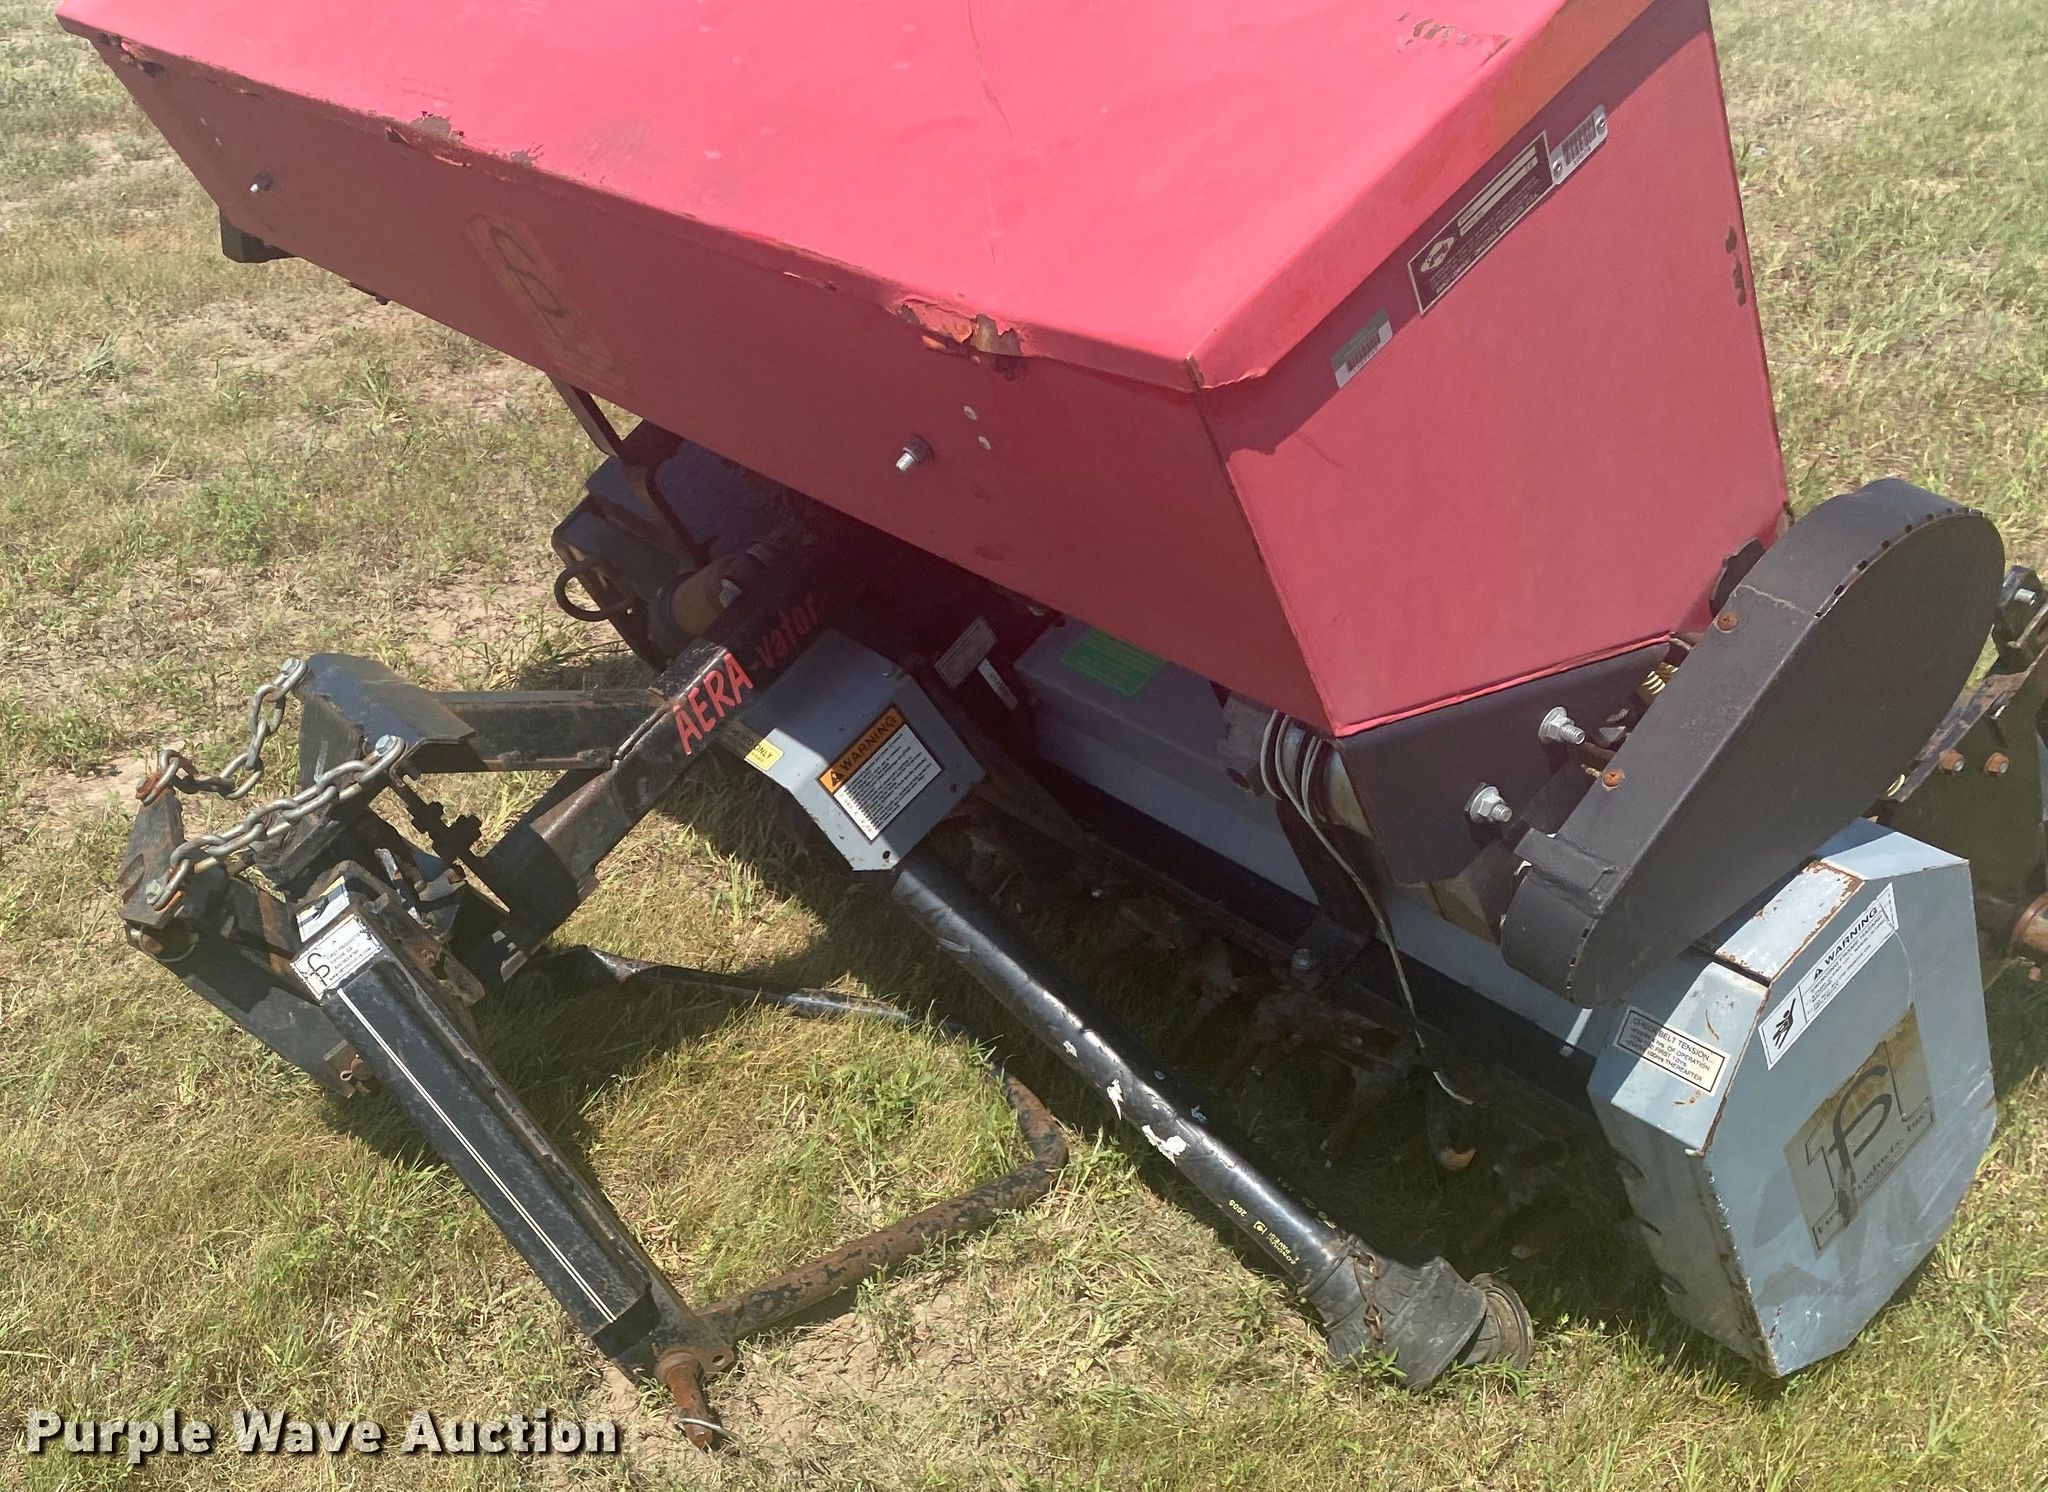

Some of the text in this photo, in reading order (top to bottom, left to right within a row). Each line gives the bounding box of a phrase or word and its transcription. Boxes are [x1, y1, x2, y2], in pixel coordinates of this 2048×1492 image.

[753, 742, 773, 760] ONLY
[840, 714, 898, 773] WARNING
[1824, 906, 1877, 964] WARNING
[1657, 1030, 1676, 1043] BELT
[1654, 1047, 1670, 1058] FIRST
[1675, 1050, 1710, 1070] OPERATION
[1664, 1058, 1702, 1081] THEREAFTER
